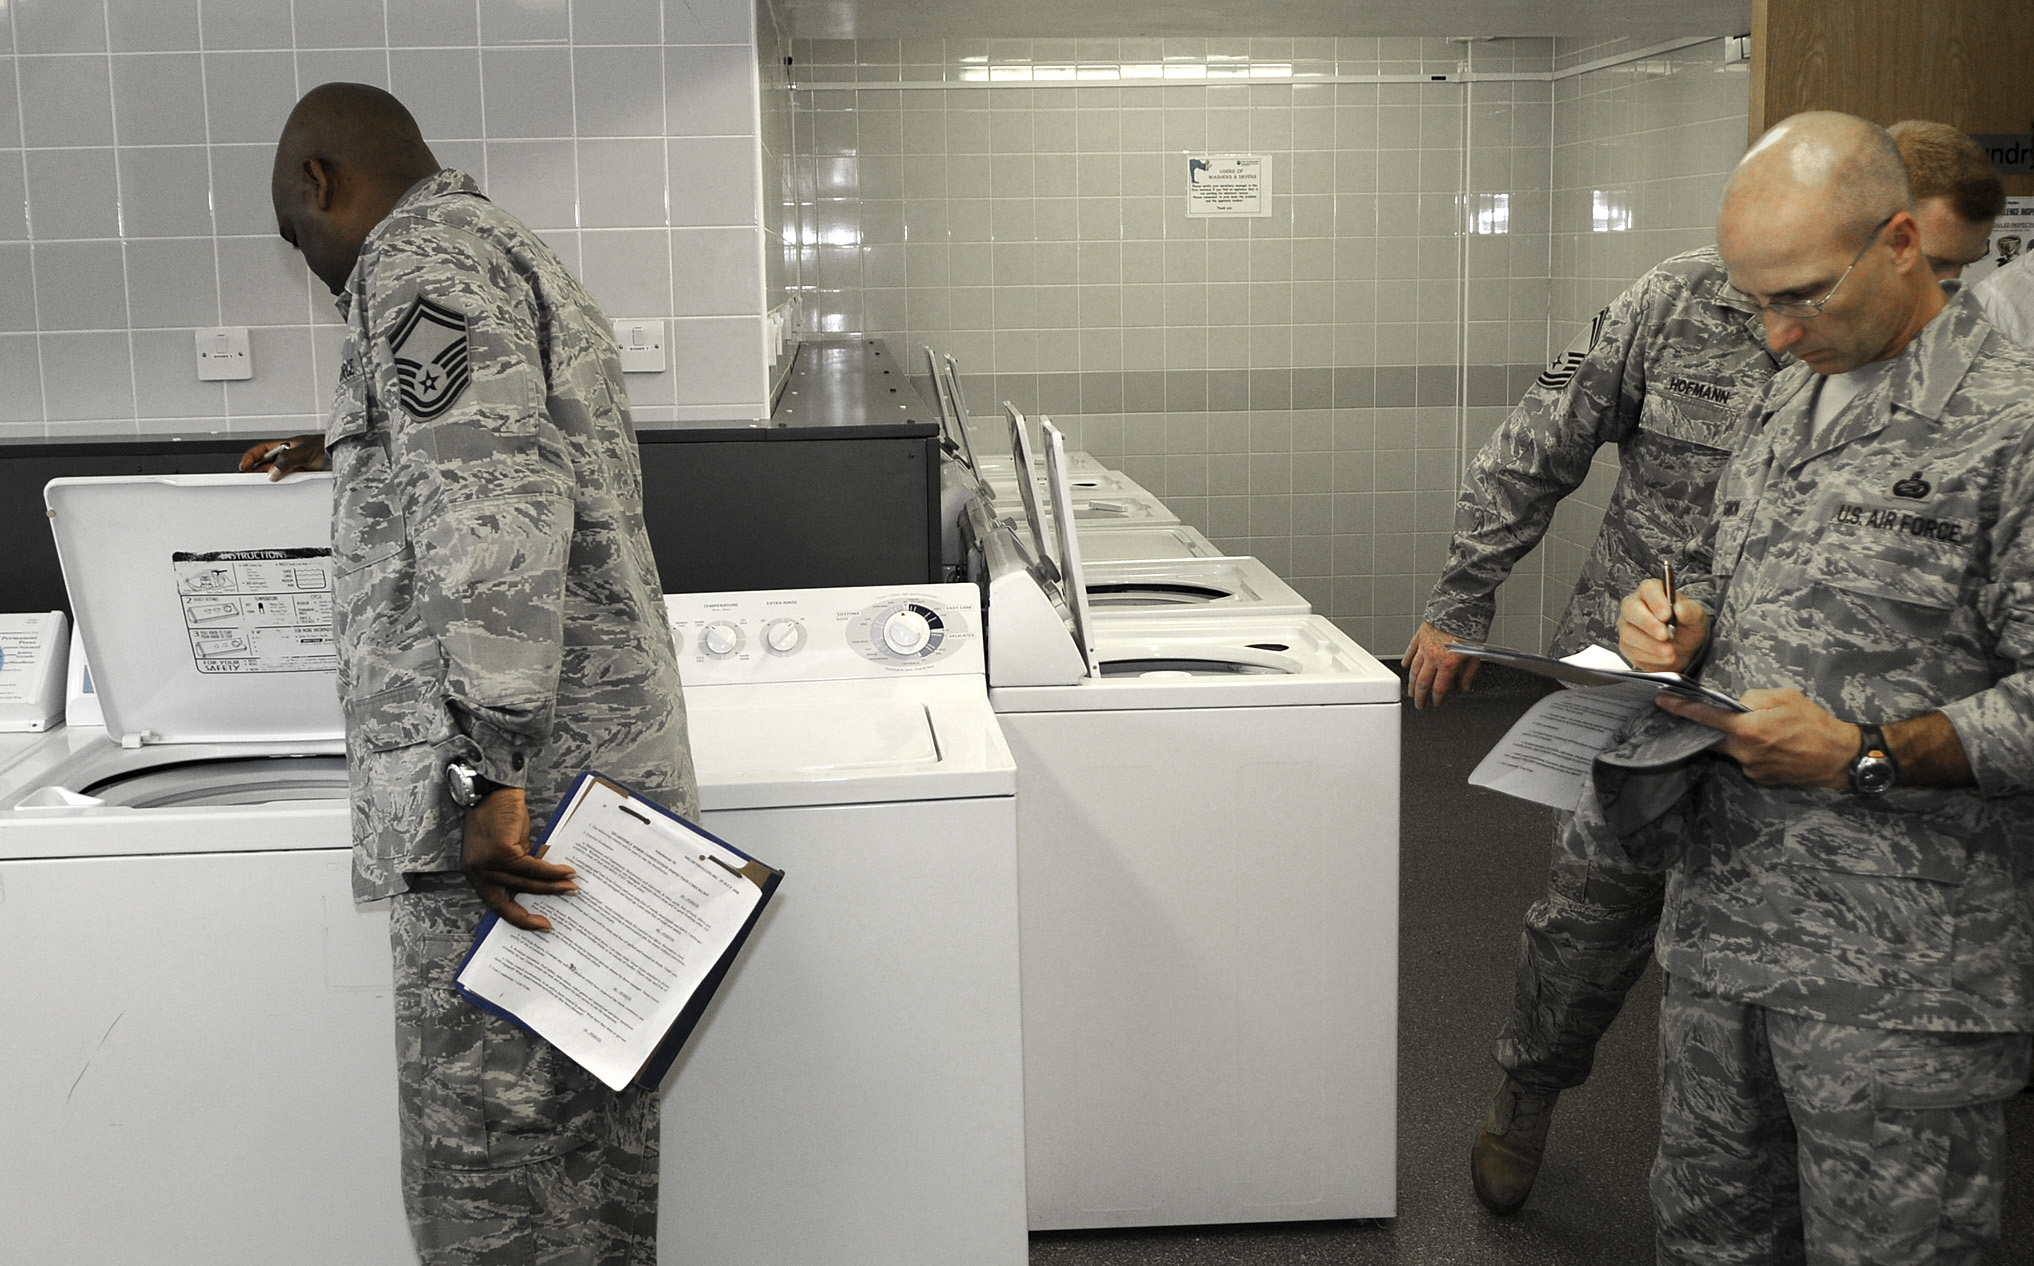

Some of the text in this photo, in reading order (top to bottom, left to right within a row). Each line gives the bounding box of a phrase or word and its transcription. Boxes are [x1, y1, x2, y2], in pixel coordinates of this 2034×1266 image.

[1986, 141, 2034, 169] ndr
[1669, 377, 1730, 403] HOFMANN
[1837, 504, 1962, 543] U.S. AIR FORCE
